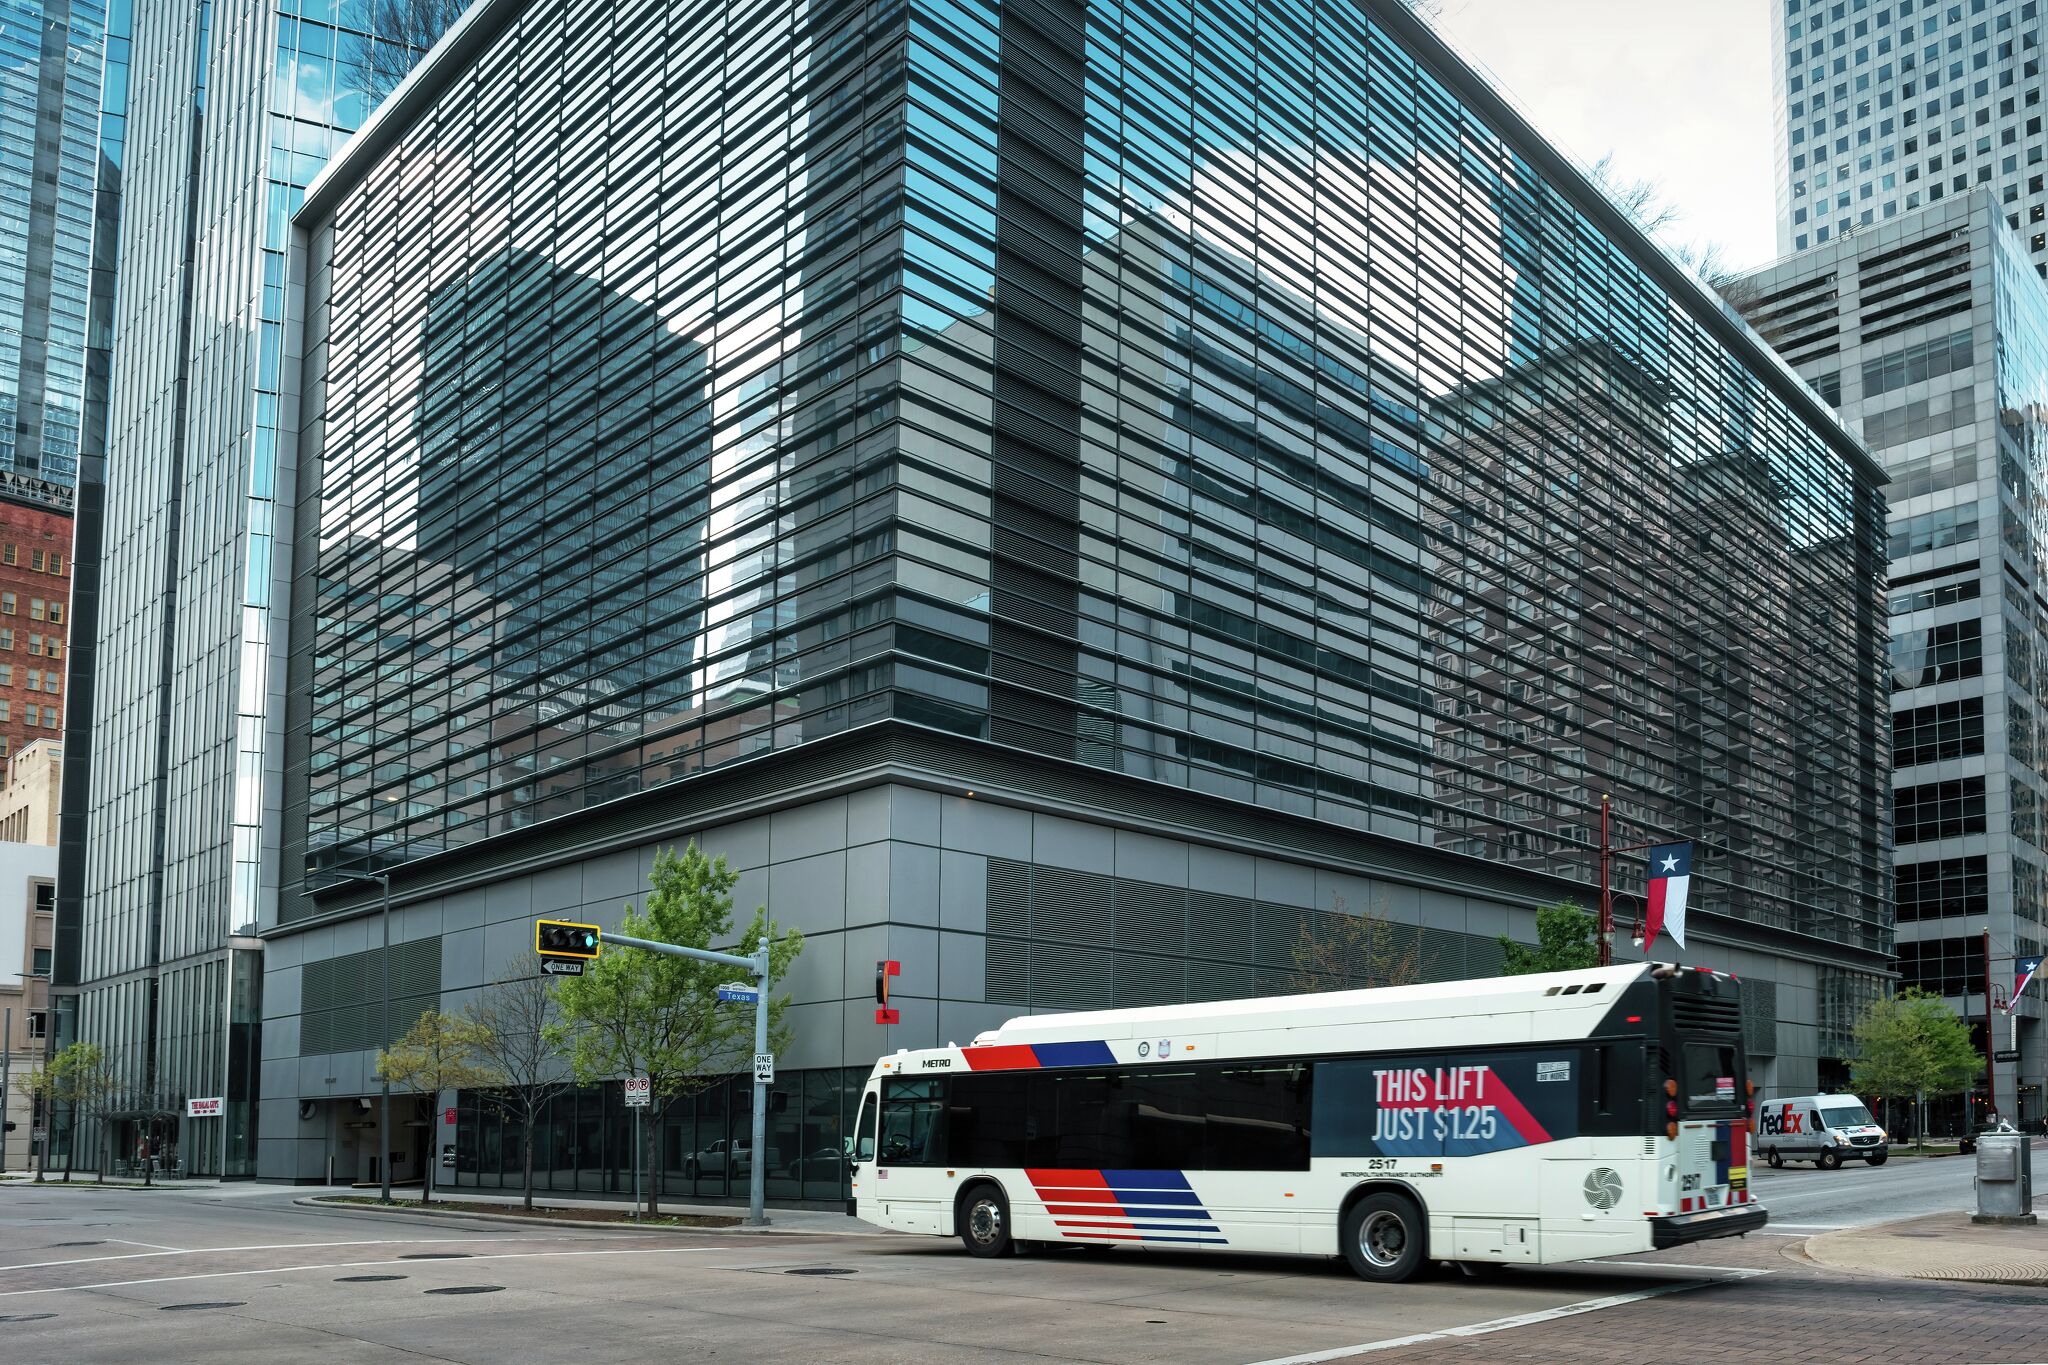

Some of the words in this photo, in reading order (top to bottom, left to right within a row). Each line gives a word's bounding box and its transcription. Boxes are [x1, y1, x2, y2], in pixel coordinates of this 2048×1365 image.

[551, 962, 564, 971] ONE
[565, 963, 580, 972] WAY
[726, 992, 750, 1001] Texas
[756, 1055, 771, 1064] ONE
[922, 1058, 951, 1068] METRO
[756, 1064, 772, 1072] WAY
[1372, 1068, 1428, 1102] THIS
[1434, 1065, 1490, 1101] LIFT
[1371, 1106, 1430, 1141] JUST
[1433, 1104, 1497, 1142] $1.25
[1760, 1104, 1804, 1136] FedEx
[1841, 1127, 1876, 1136] FedEx
[1368, 1159, 1398, 1170] 2517
[1682, 1173, 1701, 1192] 2517
